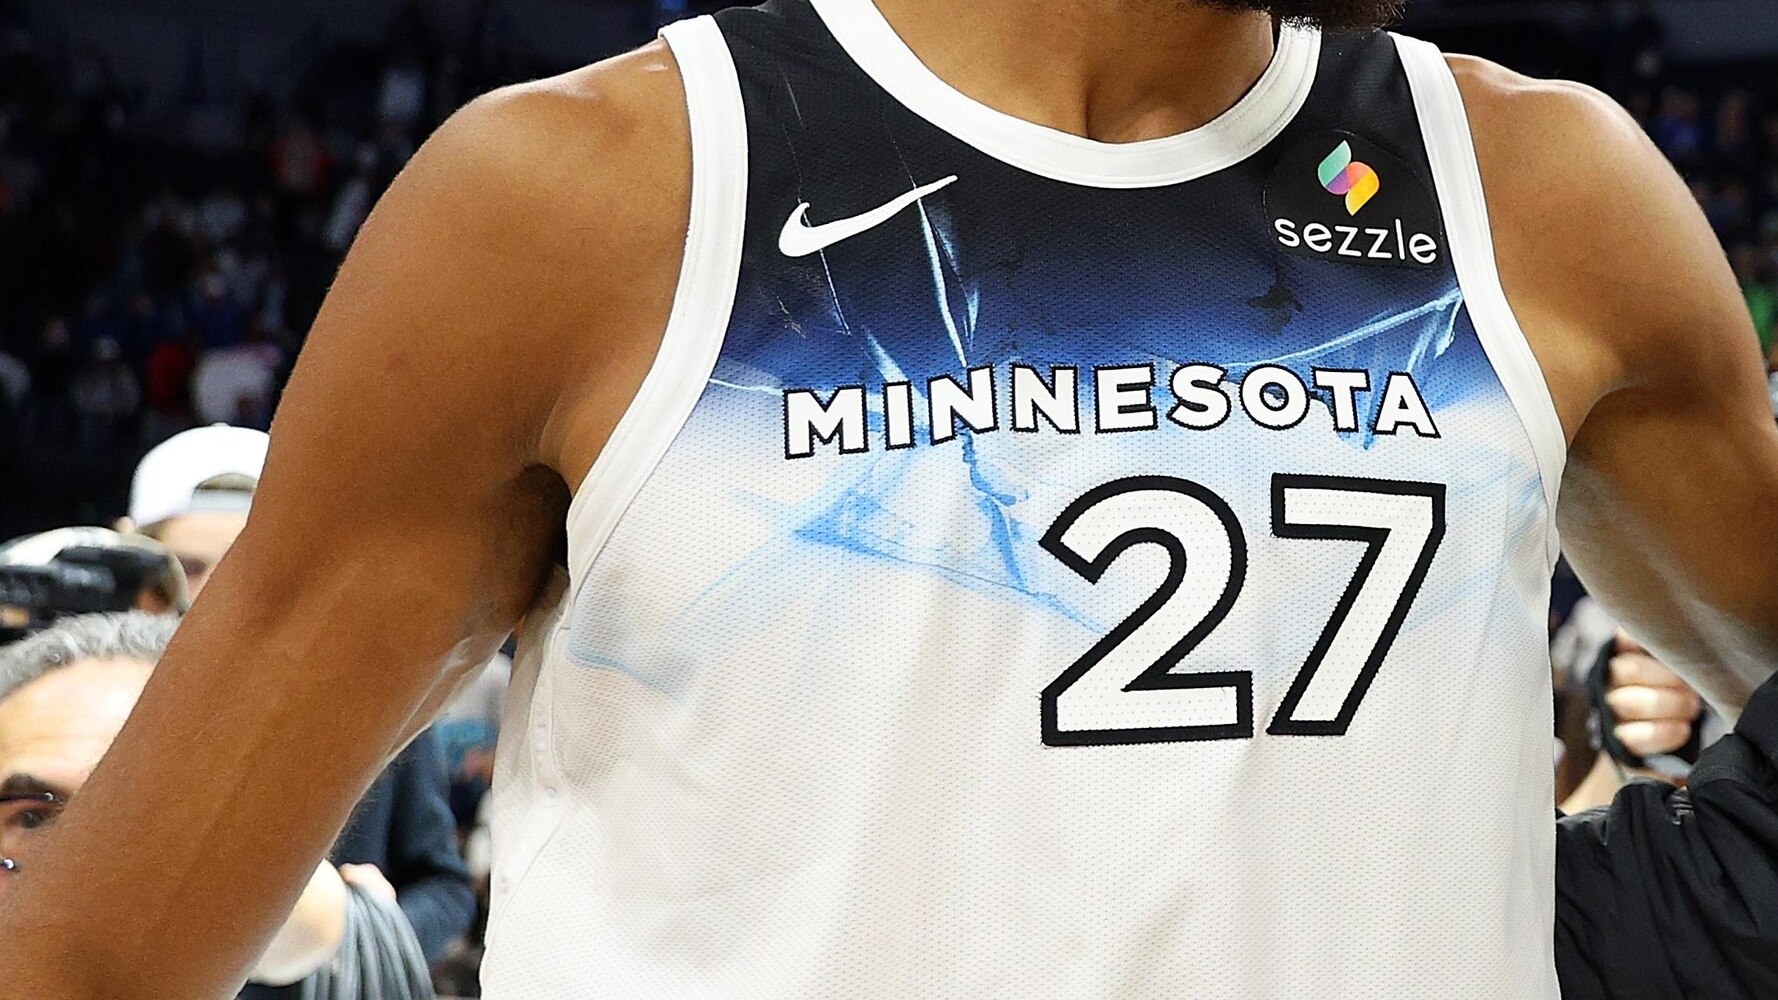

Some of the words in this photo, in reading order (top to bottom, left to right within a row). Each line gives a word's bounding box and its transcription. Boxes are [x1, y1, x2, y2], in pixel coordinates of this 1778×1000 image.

[1274, 218, 1437, 264] sezzle
[785, 362, 1441, 460] MINNESOTA
[1039, 473, 1446, 747] 27
